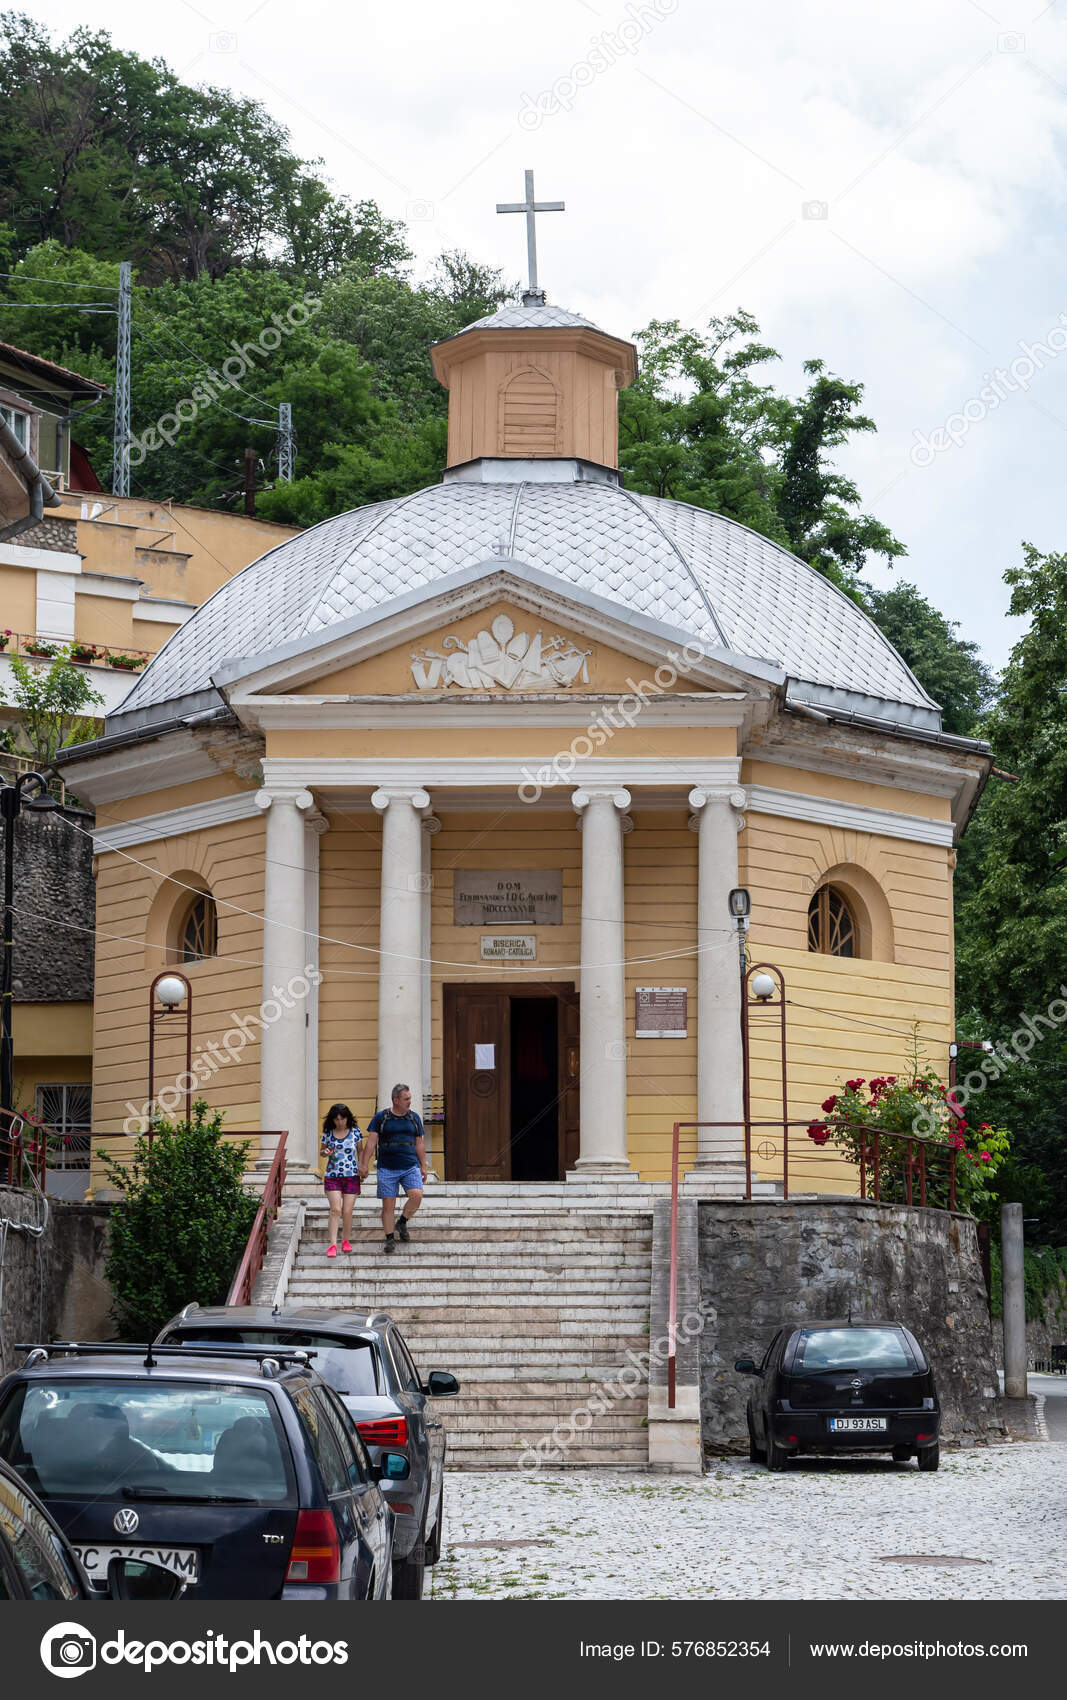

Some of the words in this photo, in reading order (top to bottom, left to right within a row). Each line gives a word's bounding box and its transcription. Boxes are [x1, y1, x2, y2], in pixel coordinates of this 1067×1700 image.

[493, 940, 527, 948] BISERICA
[836, 1419, 849, 1429] DJ
[852, 1419, 864, 1429] 93
[866, 1419, 885, 1429] ASL
[262, 1534, 284, 1544] TDI
